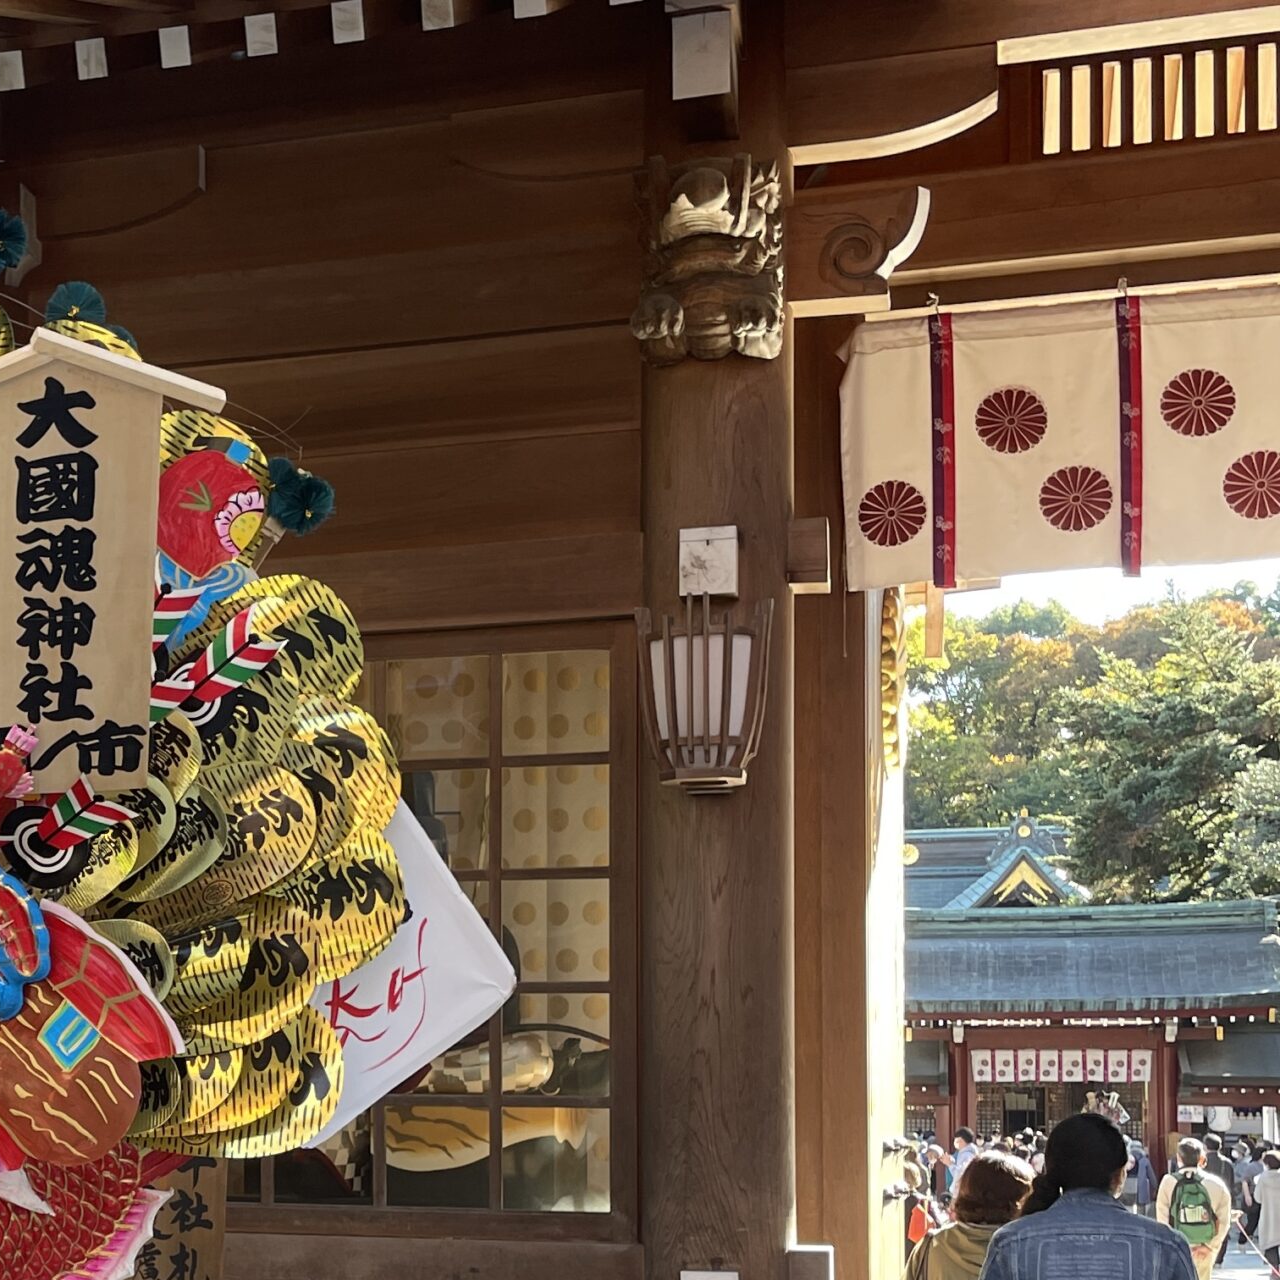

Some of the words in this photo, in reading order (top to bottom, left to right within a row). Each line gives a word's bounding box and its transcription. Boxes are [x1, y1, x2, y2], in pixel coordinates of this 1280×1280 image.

[15, 376, 99, 723] 大國魂神社
